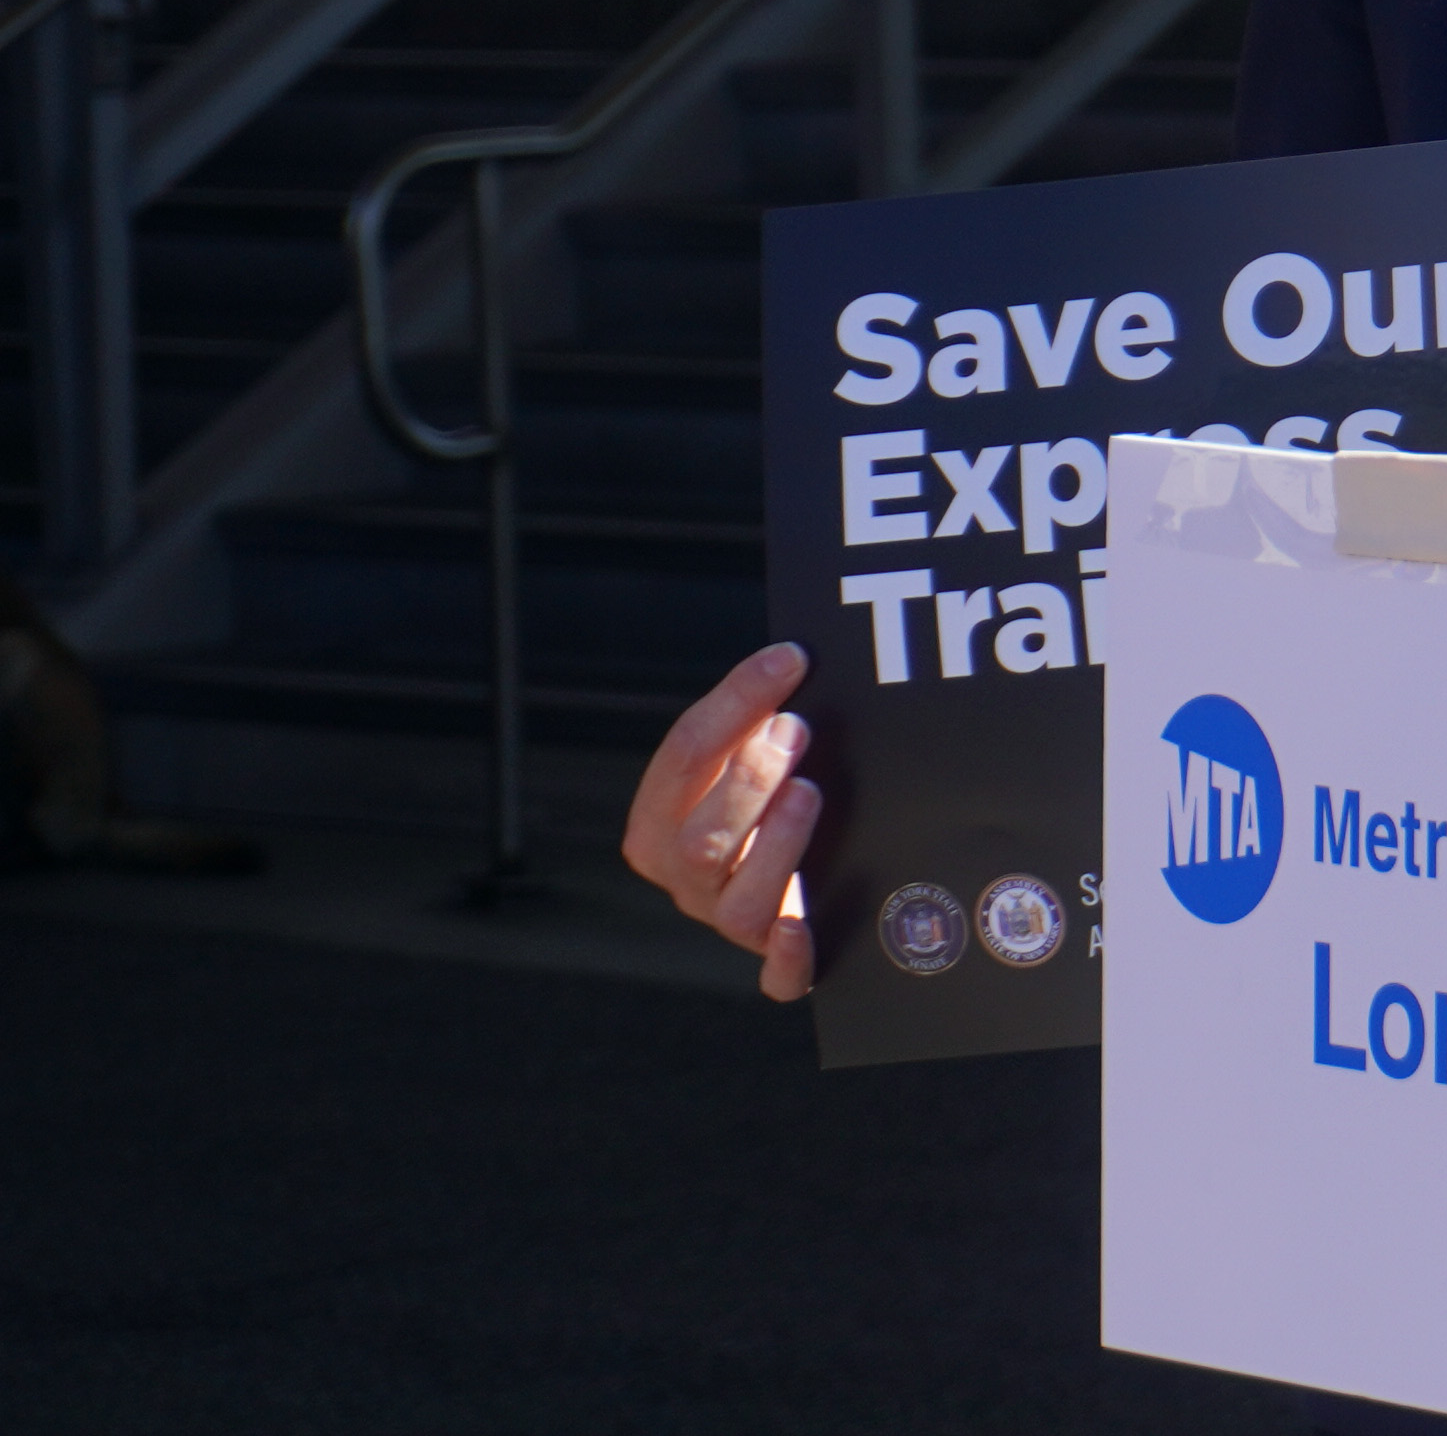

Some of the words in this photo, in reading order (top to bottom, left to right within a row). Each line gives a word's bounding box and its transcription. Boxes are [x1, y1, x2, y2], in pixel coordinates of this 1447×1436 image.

[833, 292, 1175, 406] Save
[1166, 741, 1261, 868] MTA
[1080, 873, 1102, 905] S
